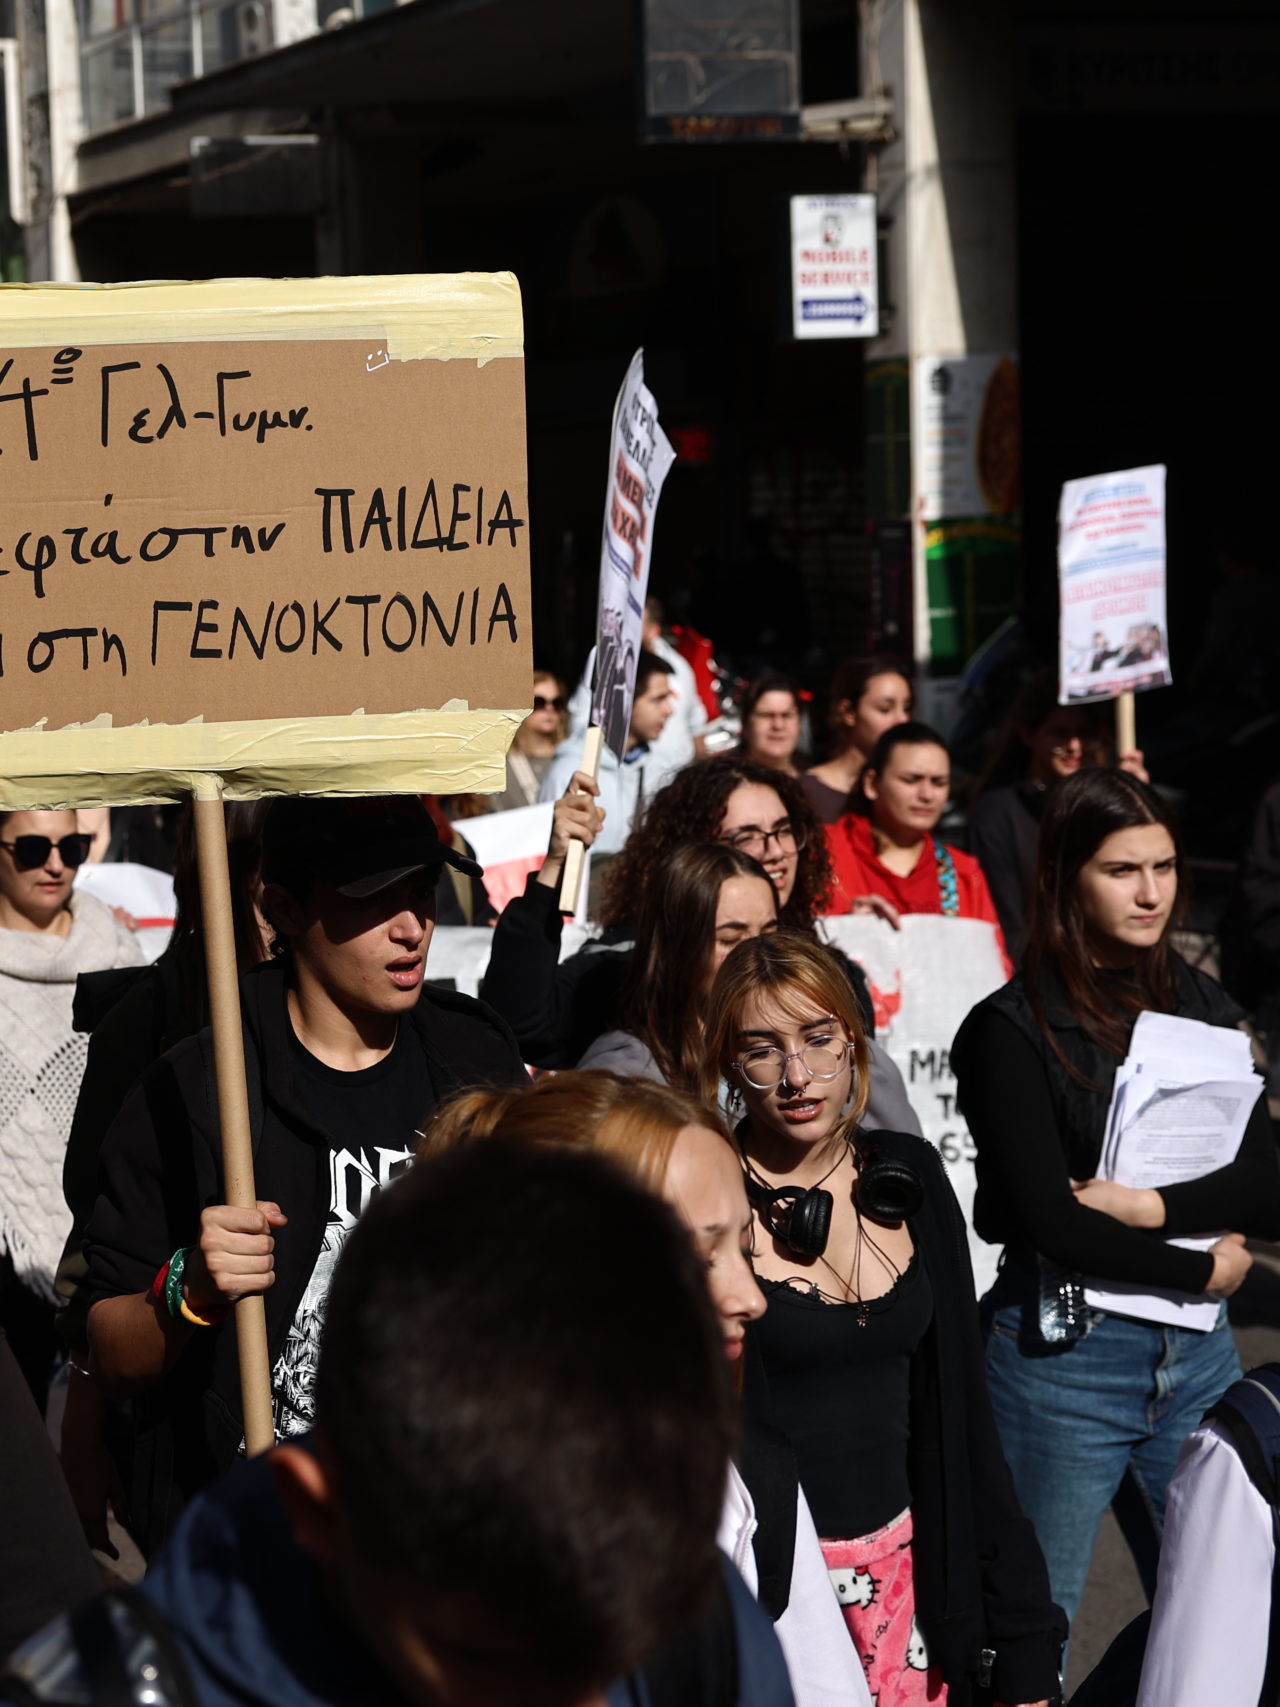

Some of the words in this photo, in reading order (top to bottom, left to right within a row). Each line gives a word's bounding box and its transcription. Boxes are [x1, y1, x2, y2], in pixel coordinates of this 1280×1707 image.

[138, 521, 287, 561] στην
[314, 477, 524, 553] ΠΑΙΔΕΙΑ
[26, 627, 127, 677] στη
[151, 582, 518, 666] ΓΕΝΟΚΤΟΝΙΑ
